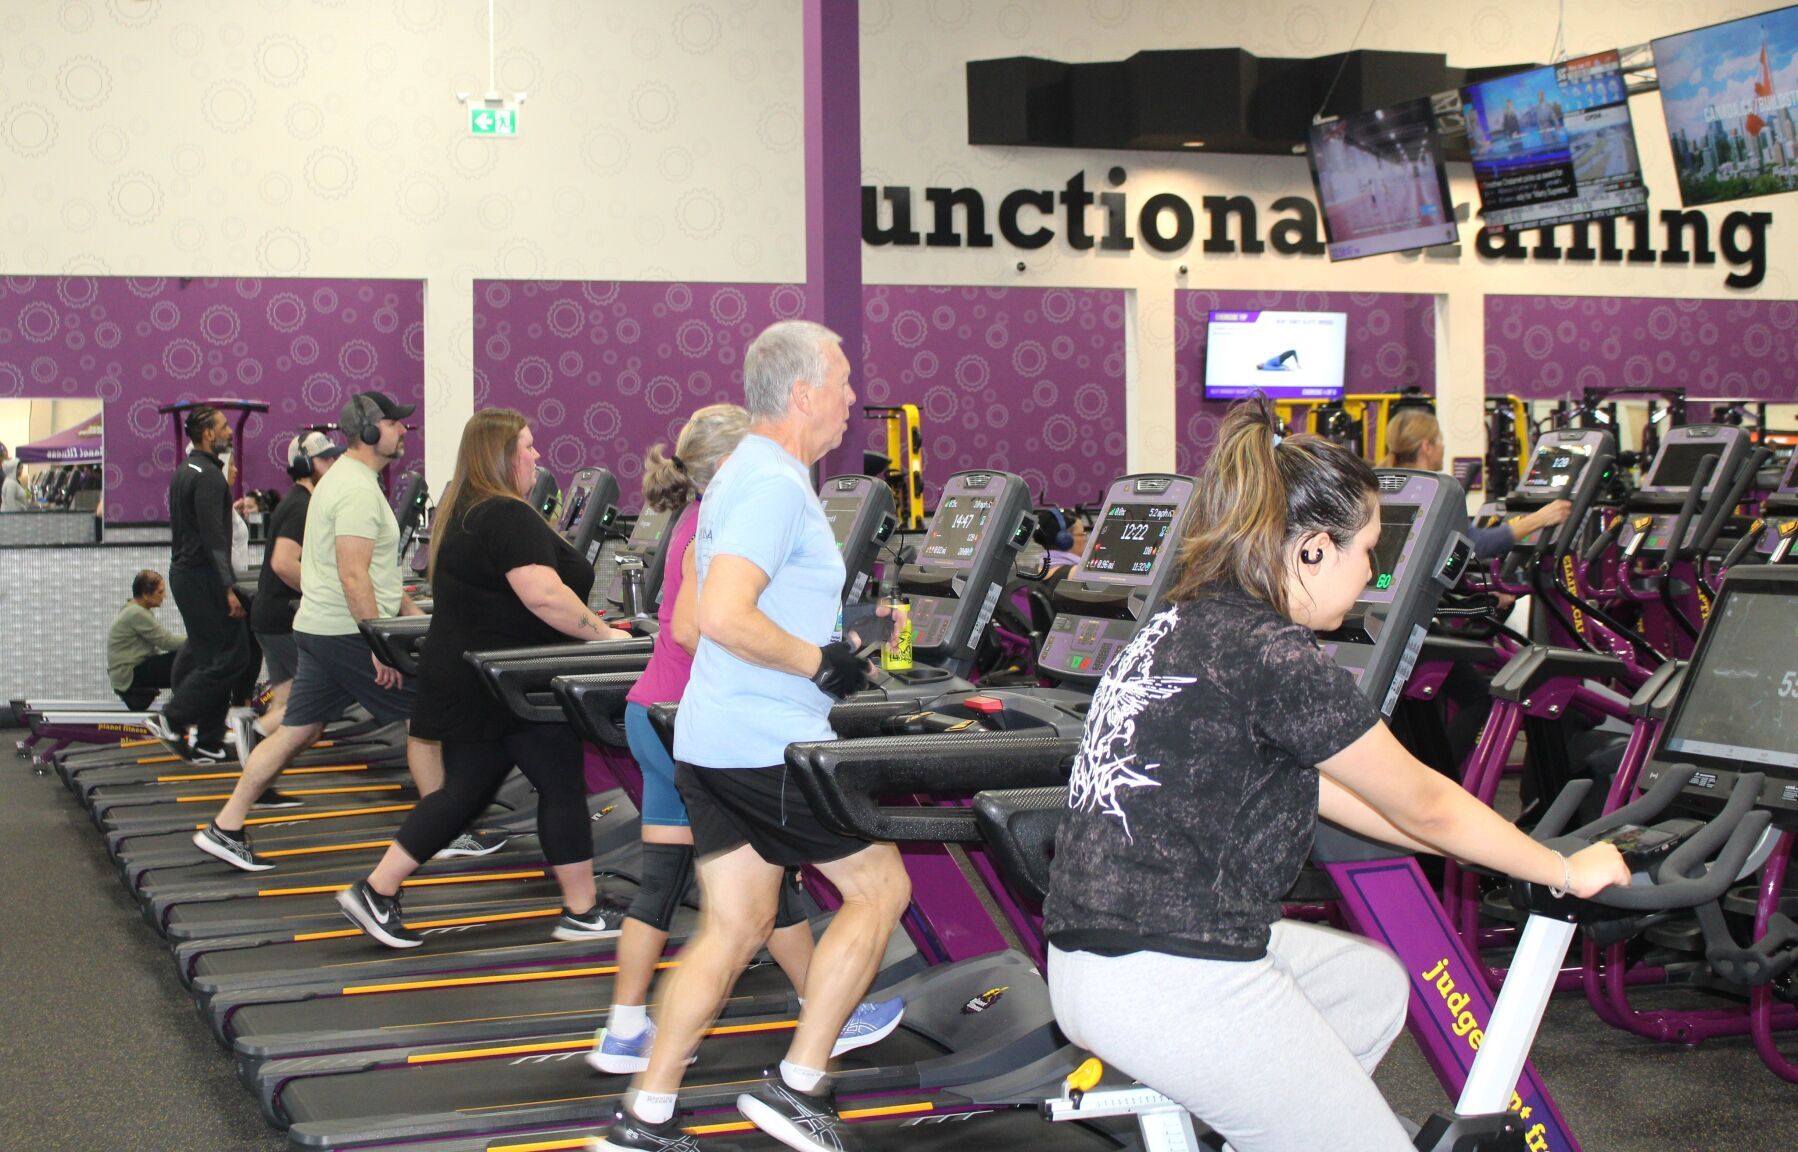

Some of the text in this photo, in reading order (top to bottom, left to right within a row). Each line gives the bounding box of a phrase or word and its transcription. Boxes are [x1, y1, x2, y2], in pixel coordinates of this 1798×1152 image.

[861, 166, 1326, 255] unctiona
[1120, 523, 1149, 541] 12:22
[98, 723, 148, 735] planet fitness
